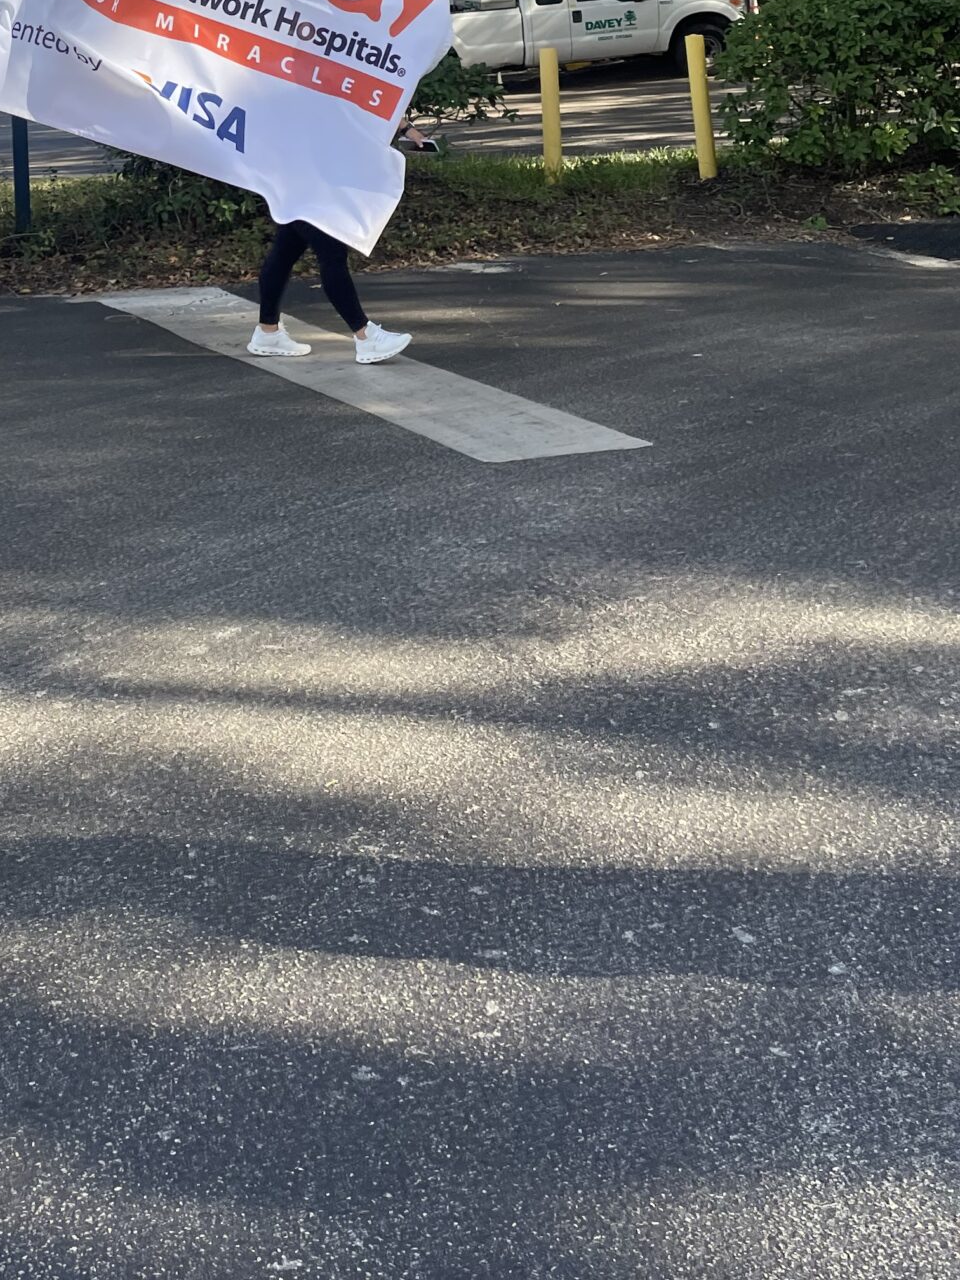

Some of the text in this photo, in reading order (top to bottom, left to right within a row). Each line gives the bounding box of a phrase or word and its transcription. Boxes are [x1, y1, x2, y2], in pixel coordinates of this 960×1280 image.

[155, 11, 384, 107] MIRACLES
[585, 17, 623, 31] DAVEY
[132, 68, 247, 154] VISA
